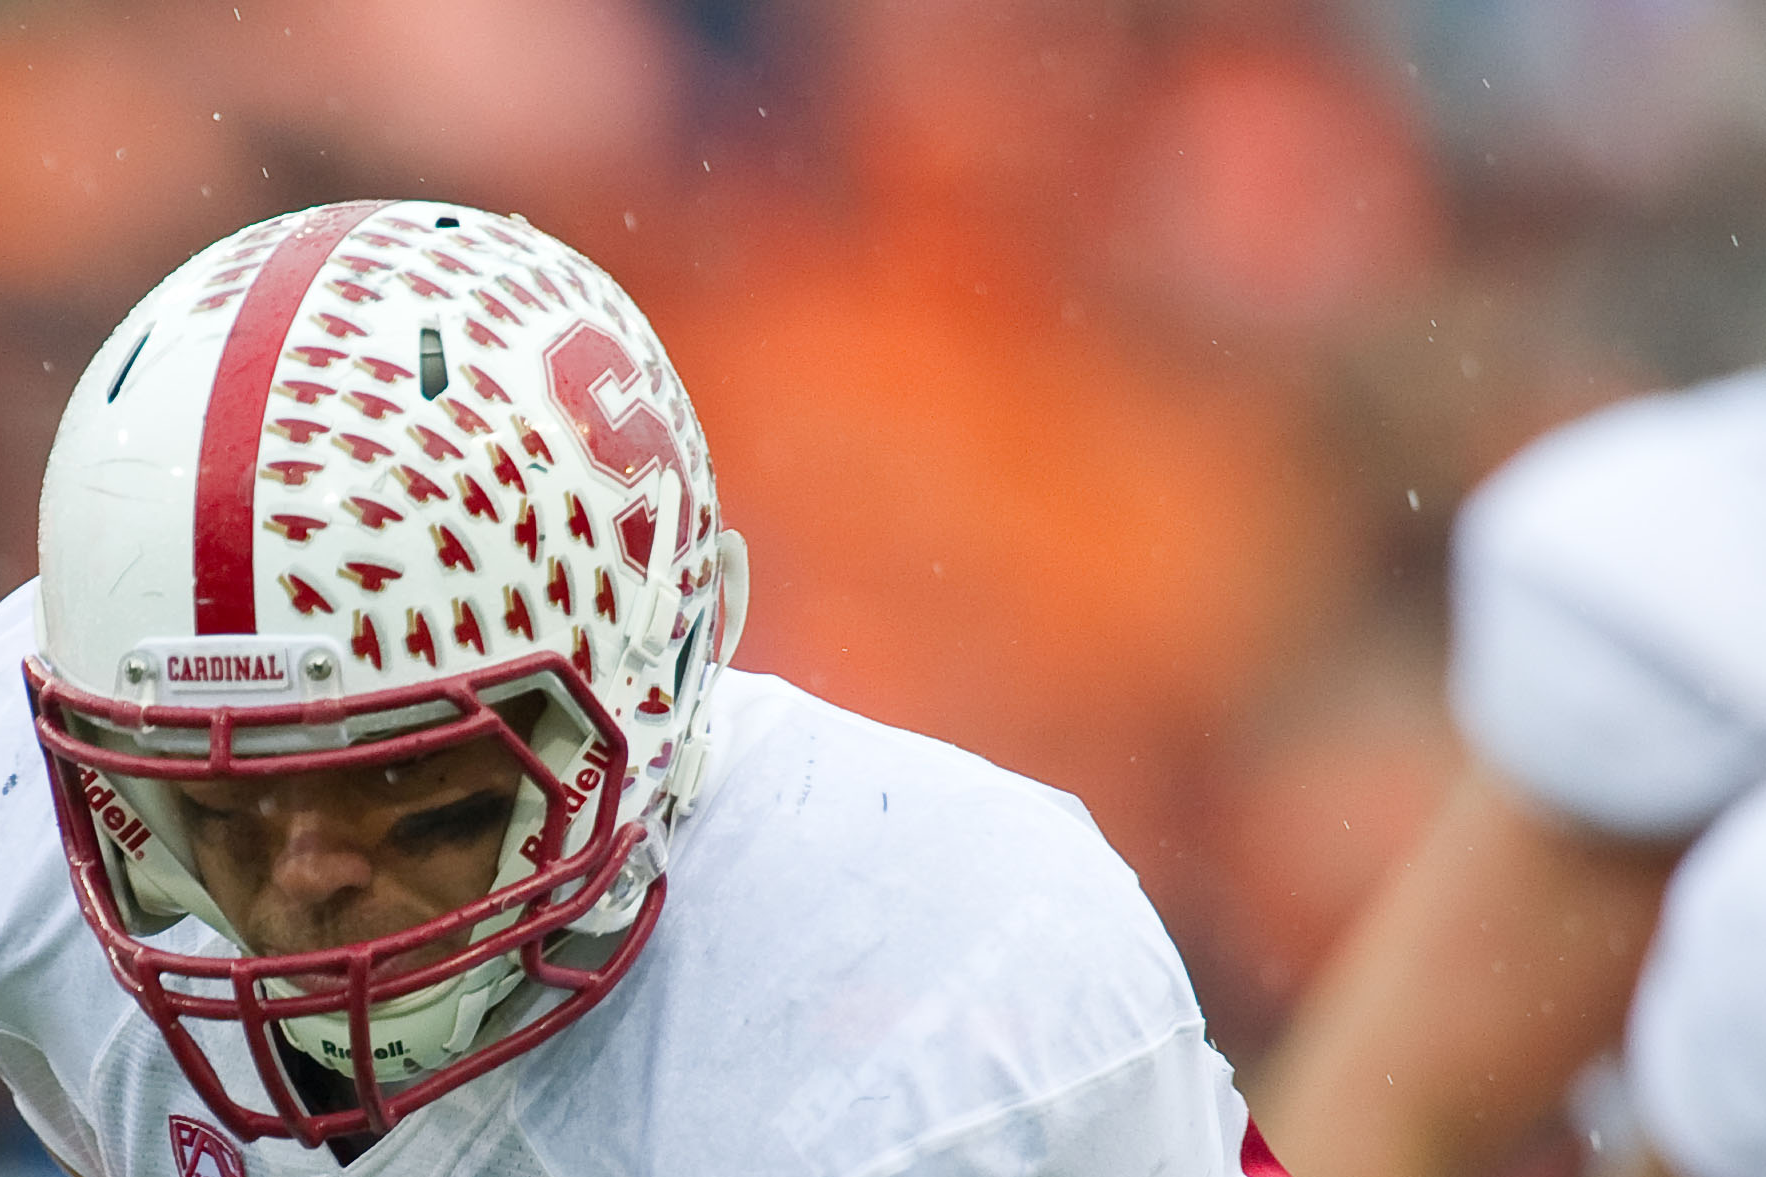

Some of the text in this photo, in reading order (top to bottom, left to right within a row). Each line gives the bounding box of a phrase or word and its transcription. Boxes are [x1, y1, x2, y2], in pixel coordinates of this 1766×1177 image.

[542, 318, 695, 582] S
[167, 655, 284, 682] CARDINAL
[80, 768, 152, 853] ddell
[518, 740, 612, 868] Rdell
[321, 1039, 405, 1060] Riell
